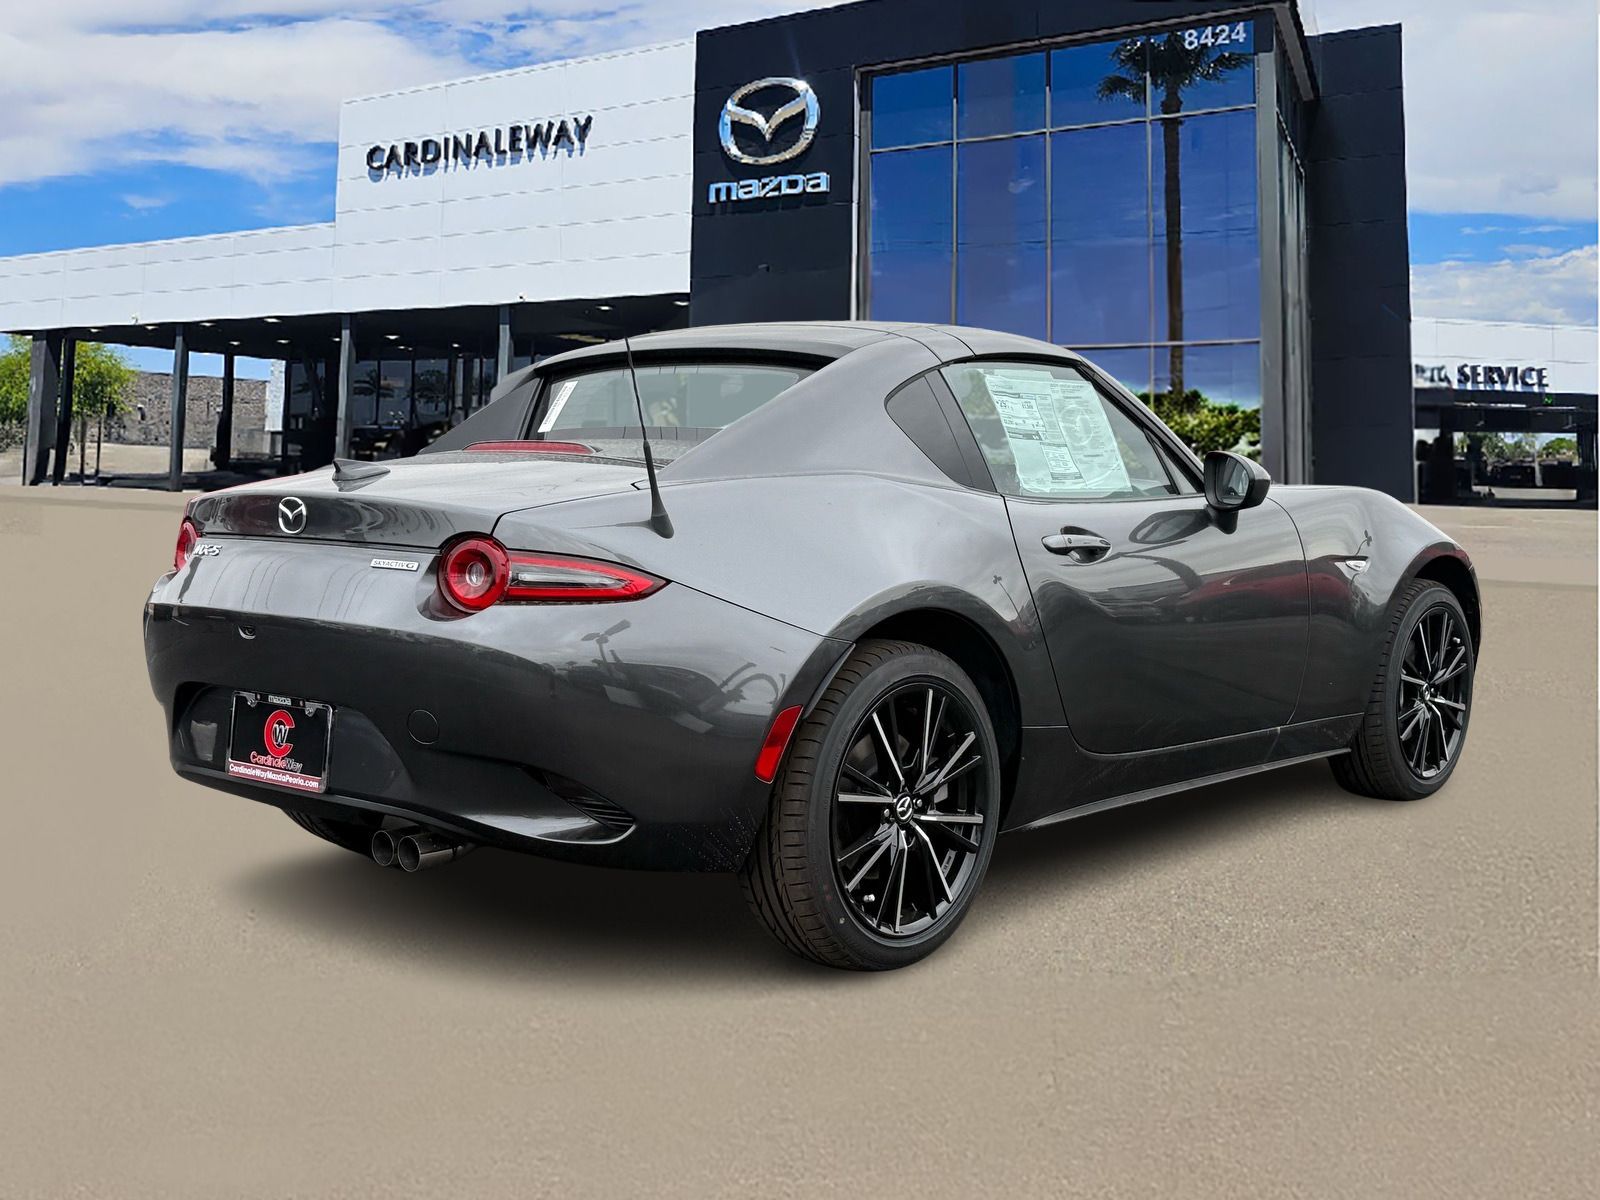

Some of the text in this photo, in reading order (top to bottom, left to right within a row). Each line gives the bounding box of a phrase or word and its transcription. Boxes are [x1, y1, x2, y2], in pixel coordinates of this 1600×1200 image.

[1184, 22, 1246, 50] 8424
[366, 115, 593, 171] CARDINALEWAY
[1457, 364, 1549, 387] SERVICE
